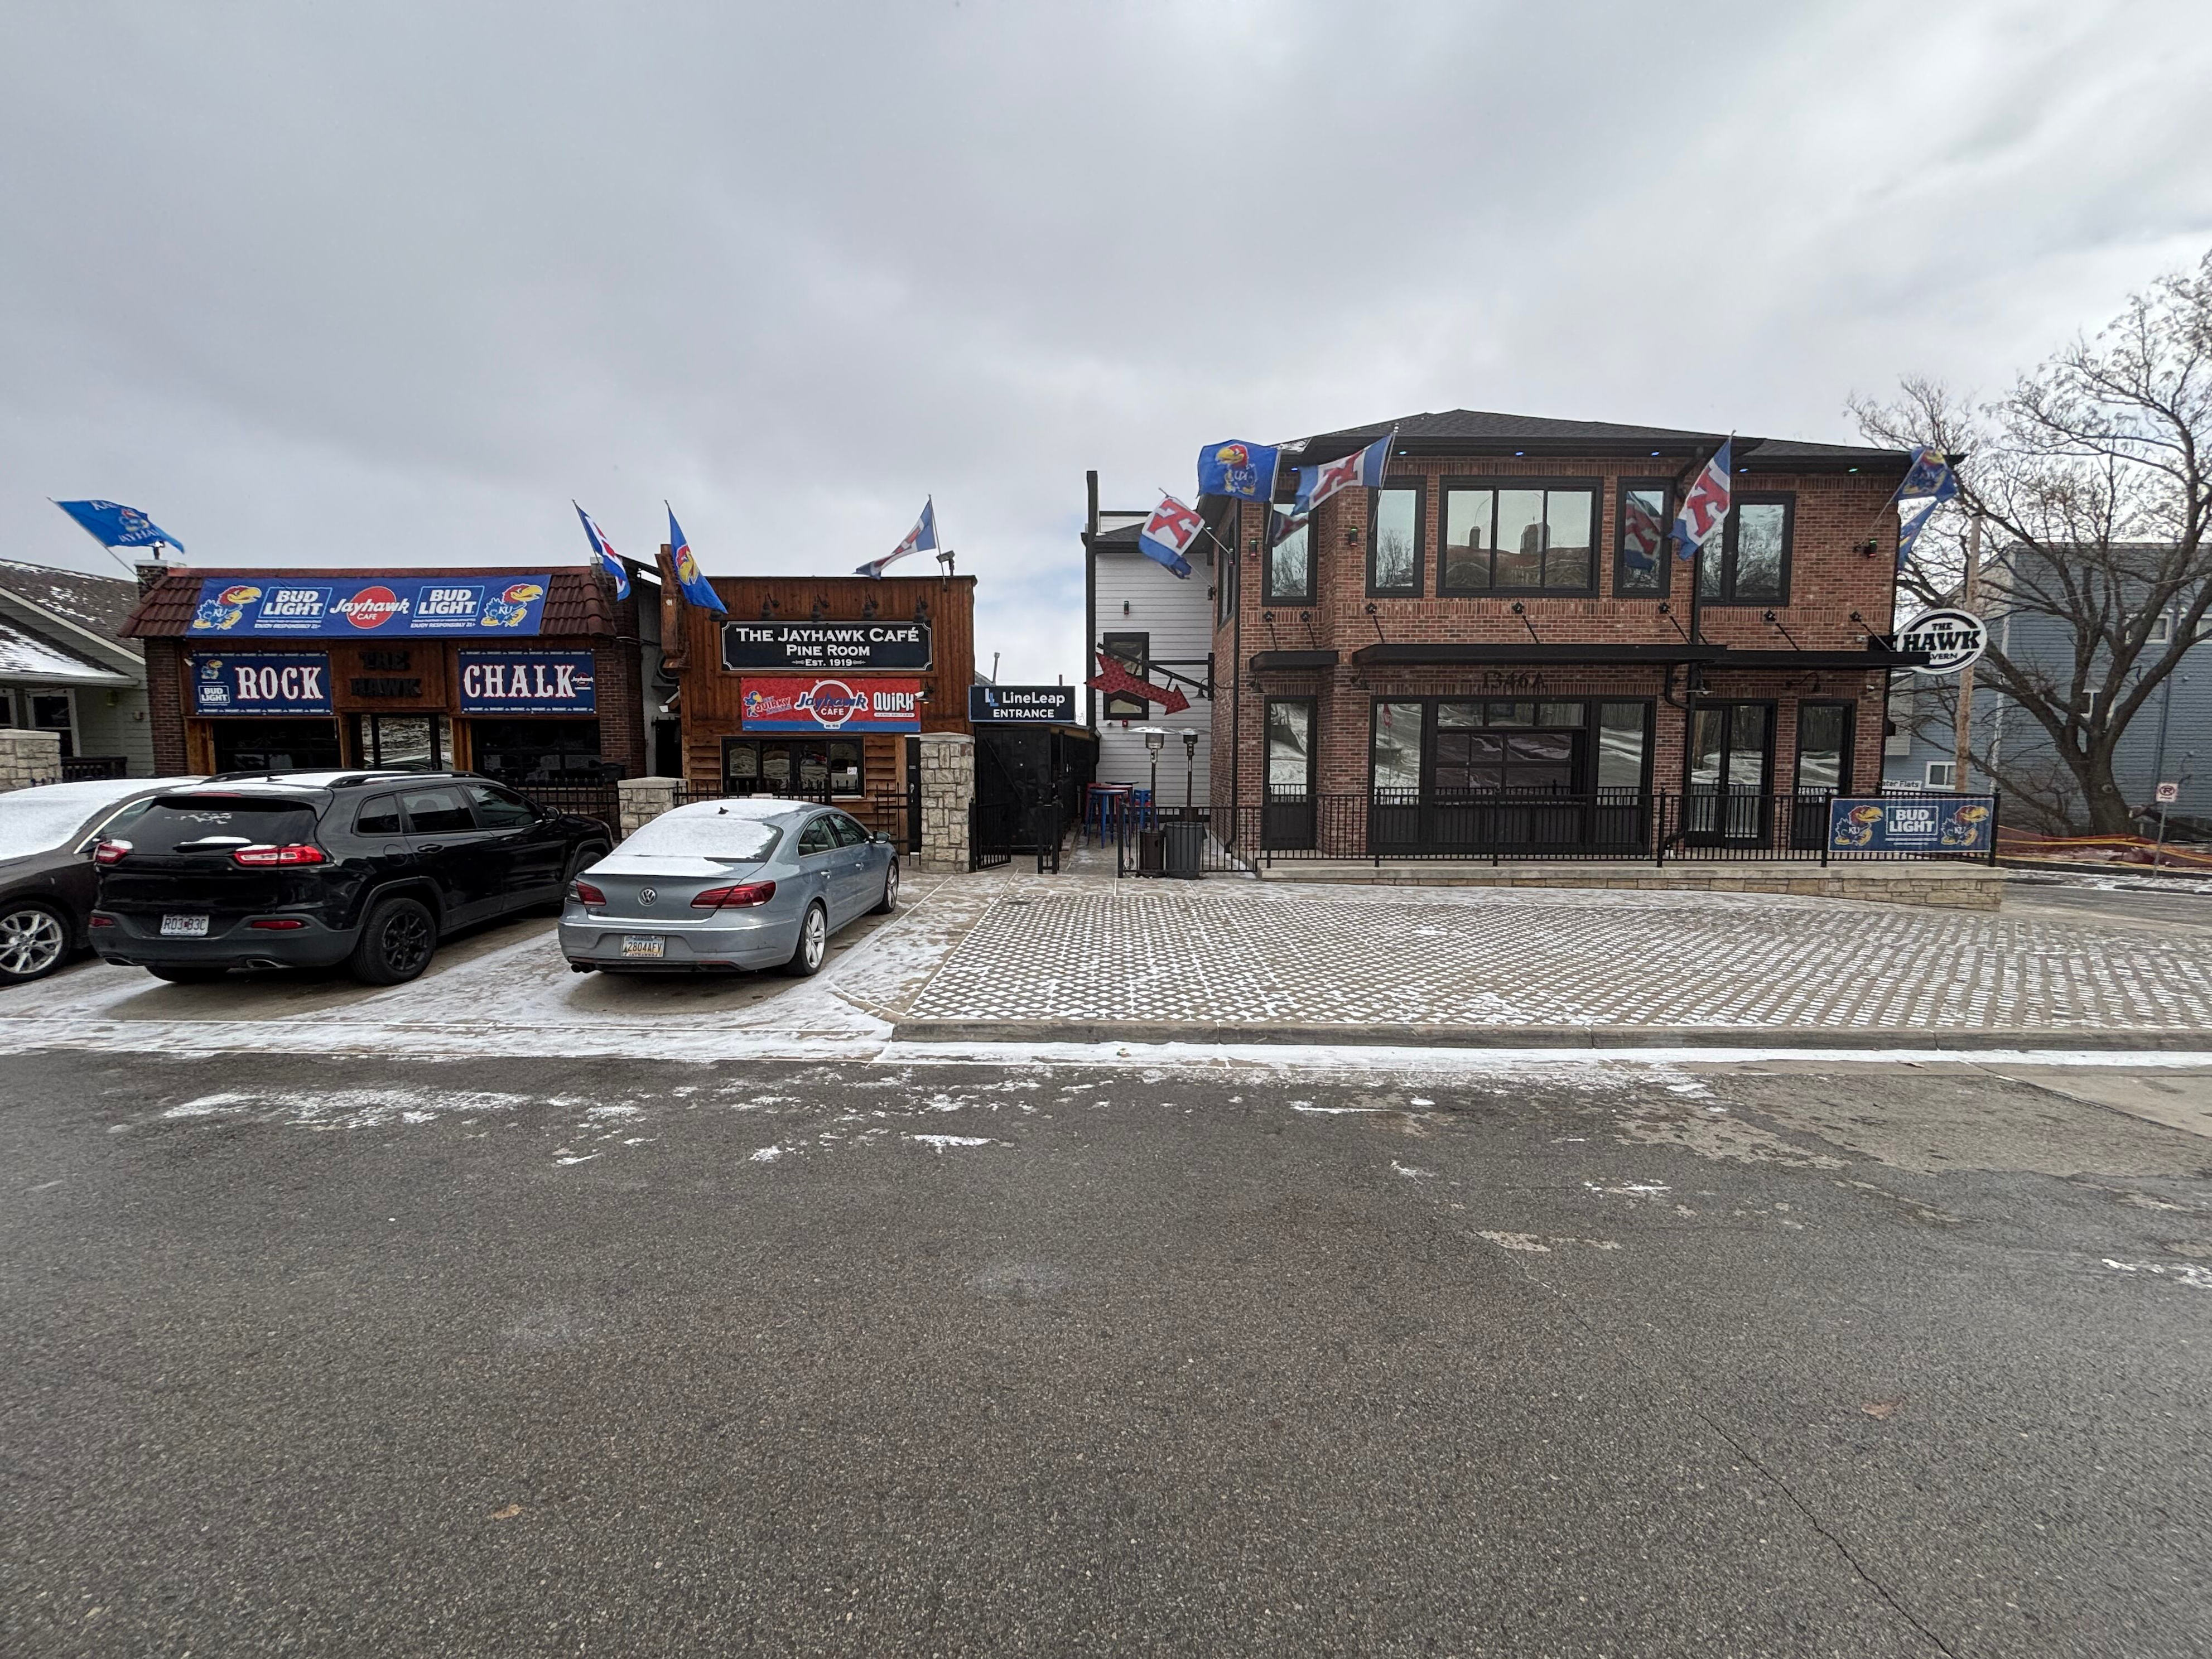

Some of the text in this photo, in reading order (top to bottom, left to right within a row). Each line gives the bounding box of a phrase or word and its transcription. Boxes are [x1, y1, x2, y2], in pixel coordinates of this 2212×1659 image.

[276, 590, 319, 602] BUD
[429, 589, 472, 602] BUD
[263, 602, 324, 615] LIGHT
[330, 598, 410, 616] Jayhawk
[418, 601, 477, 615] LIGHT
[498, 606, 513, 615] KU
[1931, 622, 1953, 631] THE
[736, 626, 919, 642] THE JAYHAWK CAFÉ
[1902, 630, 1982, 652] HAWK
[786, 644, 870, 656] PINE ROOM
[235, 666, 324, 700] ROCK
[464, 664, 576, 698] CHALK
[794, 692, 868, 712] Jayhawk
[1002, 691, 1066, 707] LineLeap
[993, 708, 1054, 718] ENTRANCE
[1896, 809, 1929, 821] BUD
[1848, 826, 1860, 835] KU
[1889, 821, 1935, 833] LIGHT
